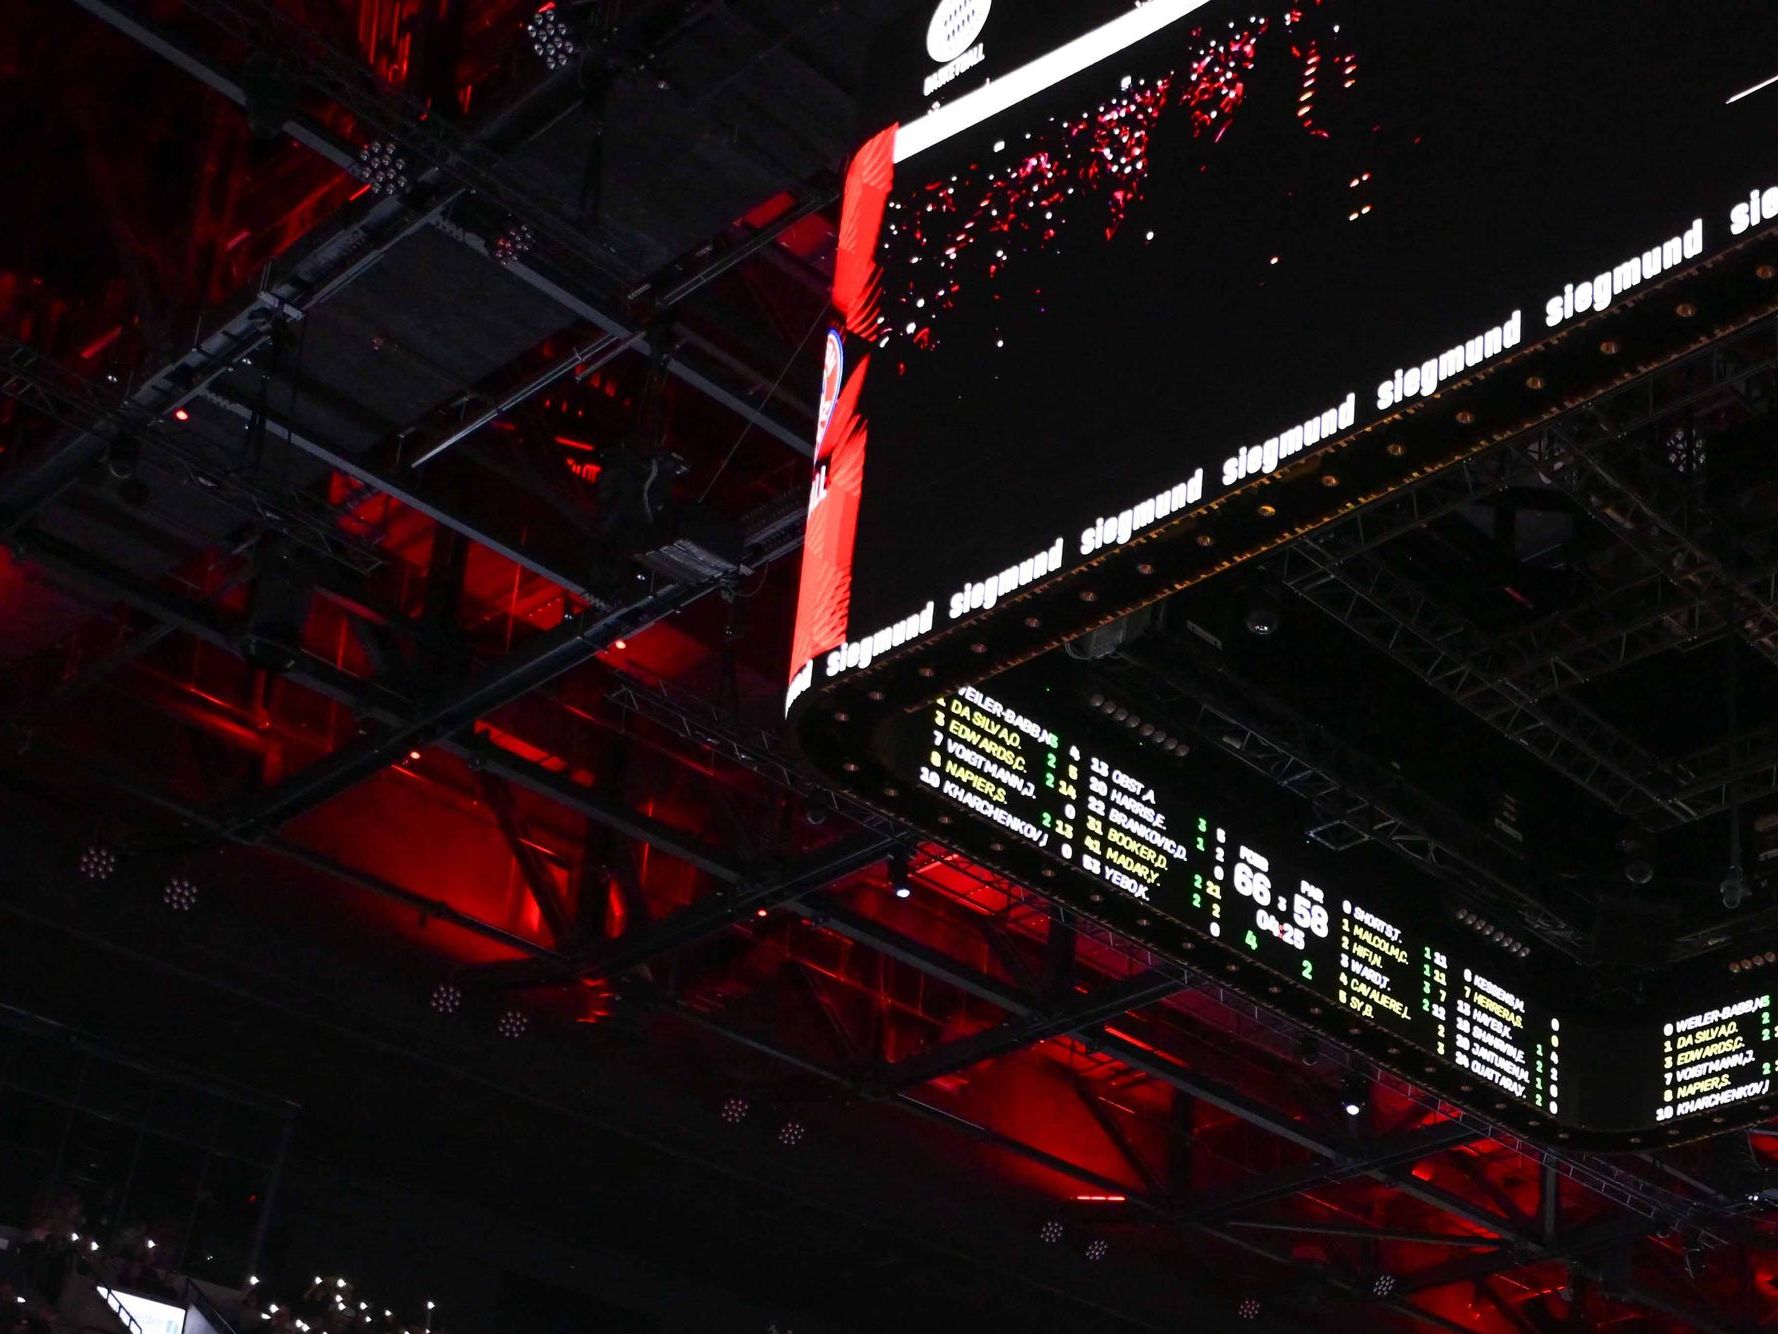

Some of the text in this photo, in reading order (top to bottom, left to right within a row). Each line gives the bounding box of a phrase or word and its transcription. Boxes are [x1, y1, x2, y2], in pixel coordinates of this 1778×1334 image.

[1545, 219, 1703, 328] siegmund
[1377, 307, 1520, 410] siegmund
[1222, 394, 1355, 485] siegmund
[1080, 469, 1203, 556] siegmund
[949, 537, 1064, 619] siegmund
[826, 601, 934, 677] siegmund
[1233, 862, 1271, 906] 66
[1293, 894, 1329, 938] 58
[1256, 909, 1305, 950] 04:25
[1302, 960, 1312, 980] 2
[1664, 1023, 1673, 1036] 0
[1664, 1040, 1672, 1052] 1
[1664, 1056, 1673, 1069] 3
[1664, 1072, 1673, 1085] 7
[1656, 1106, 1674, 1121] 10
